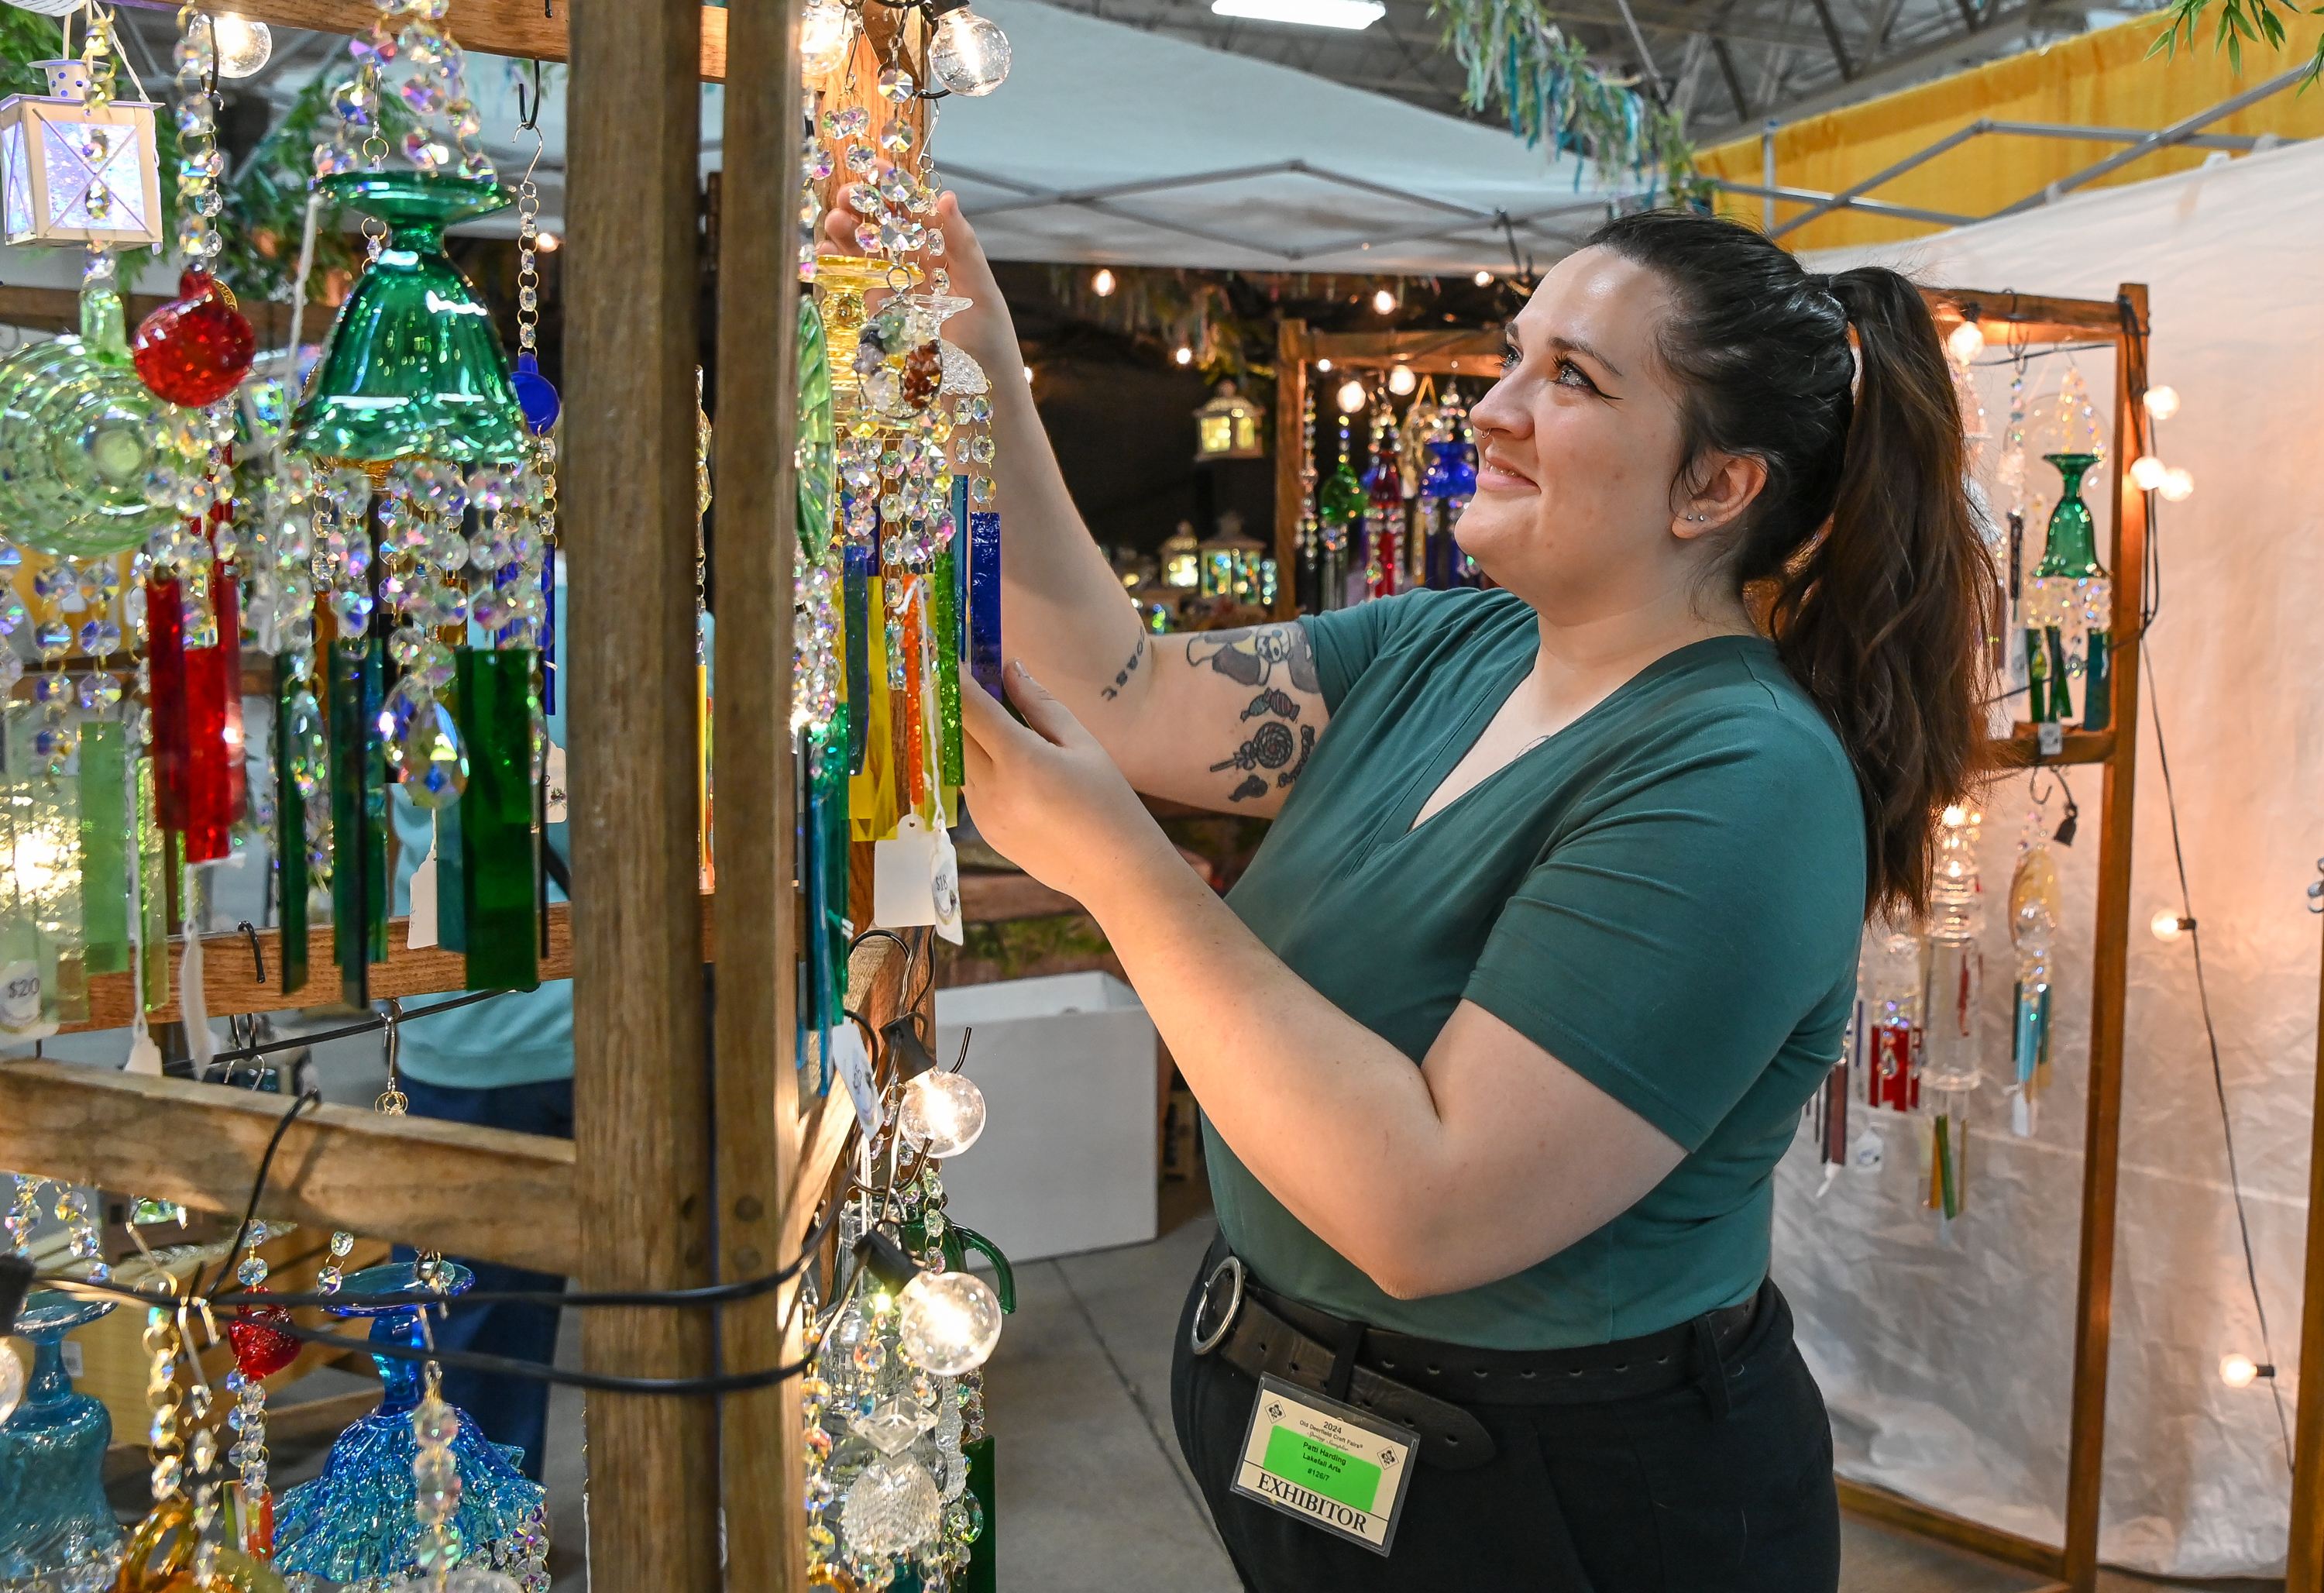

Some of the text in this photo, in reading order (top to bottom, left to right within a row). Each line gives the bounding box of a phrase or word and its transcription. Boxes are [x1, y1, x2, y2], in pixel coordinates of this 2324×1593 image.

[935, 874, 948, 891] $18
[9, 977, 40, 998] $20
[1299, 1419, 1309, 1428] Old
[1309, 1424, 1332, 1437] Deerfield
[1333, 1434, 1346, 1443] Craft
[1323, 1421, 1342, 1434] 2024
[1302, 1441, 1346, 1466] Patti Harding
[1303, 1453, 1342, 1474] Lakefall Arts
[1307, 1467, 1330, 1481] #126/7
[1257, 1472, 1367, 1534] EXHIBITOR
